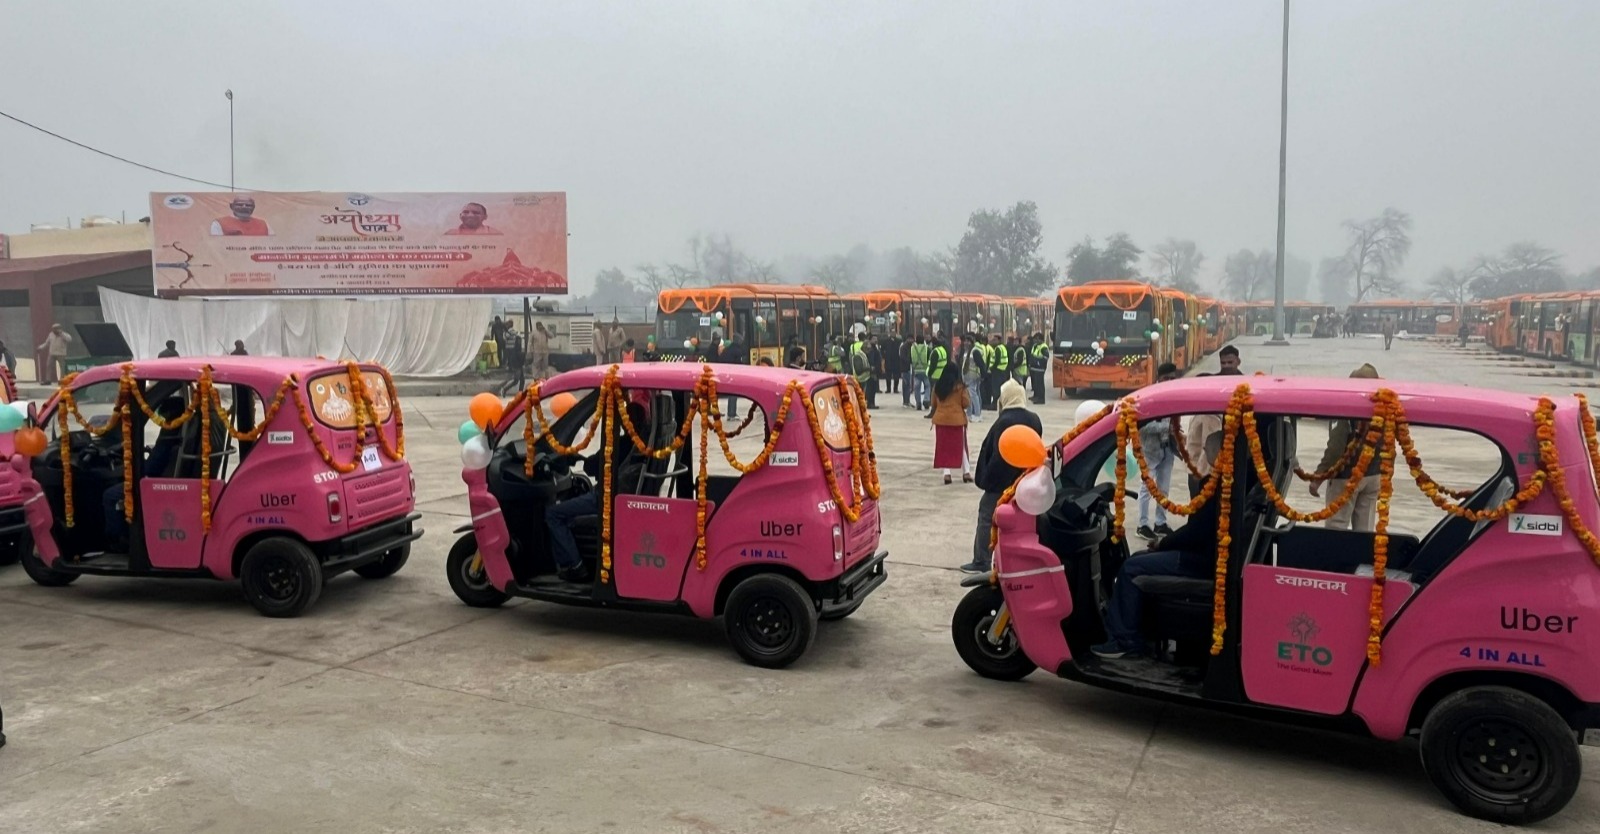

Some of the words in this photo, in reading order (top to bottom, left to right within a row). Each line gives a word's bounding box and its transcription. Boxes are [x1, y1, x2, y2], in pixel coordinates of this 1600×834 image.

[319, 206, 402, 236] अयोध्या
[778, 456, 798, 464] sidbi
[260, 493, 297, 508] Uber
[626, 501, 670, 514] स्वागतम्
[269, 516, 286, 525] ALL
[760, 520, 804, 537] Uber
[1526, 520, 1560, 532] sidbi
[158, 529, 187, 541] ETO
[632, 553, 666, 570] ETO
[740, 548, 747, 557] 4
[750, 549, 763, 558] IN
[766, 549, 788, 559] ALL
[1275, 574, 1349, 596] स्वागतम्
[1500, 605, 1579, 634] Uber
[1277, 641, 1333, 666] ETO
[1459, 646, 1471, 658] 4
[1478, 648, 1499, 661] IN
[1506, 651, 1546, 667] ALL
